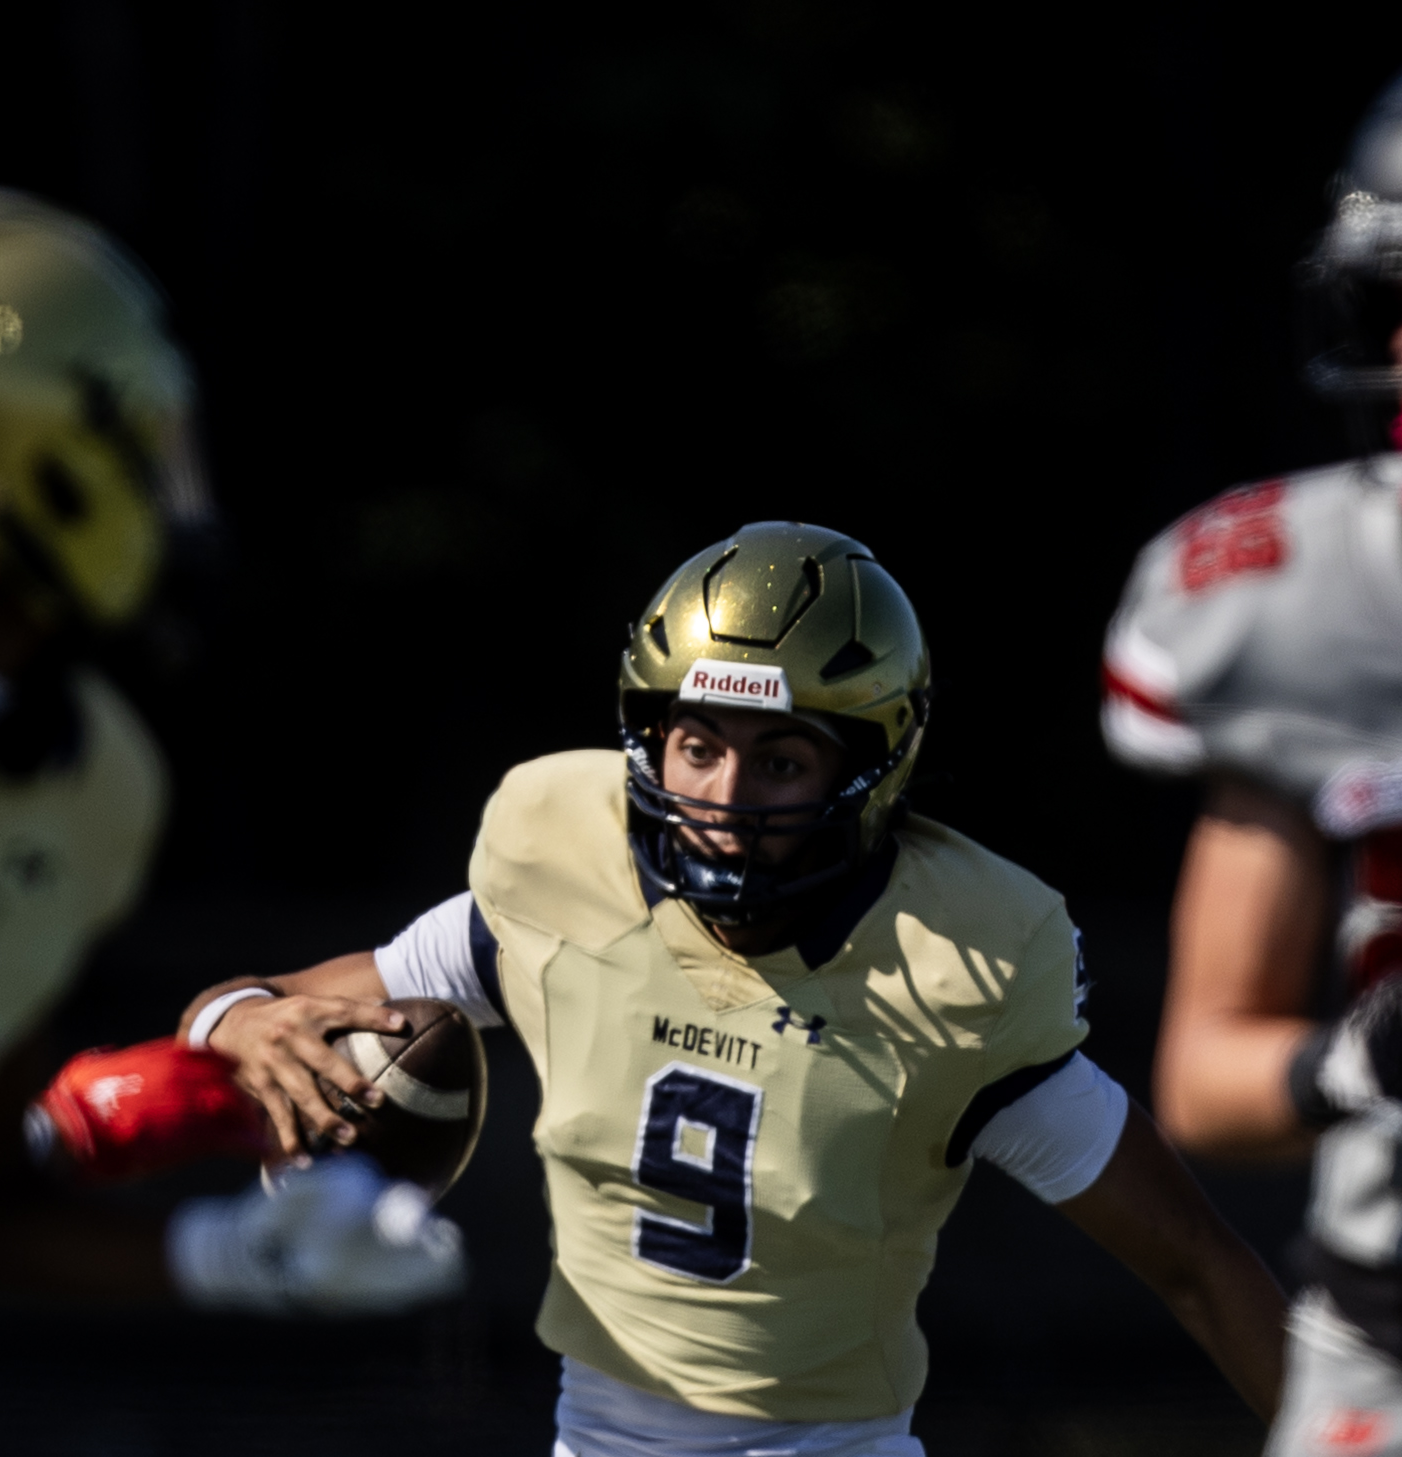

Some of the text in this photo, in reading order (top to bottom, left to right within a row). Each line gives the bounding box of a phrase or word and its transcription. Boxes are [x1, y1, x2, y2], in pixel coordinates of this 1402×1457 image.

[692, 670, 780, 698] Riddell
[652, 1015, 763, 1070] McDEVITT
[630, 1060, 763, 1286] 9
